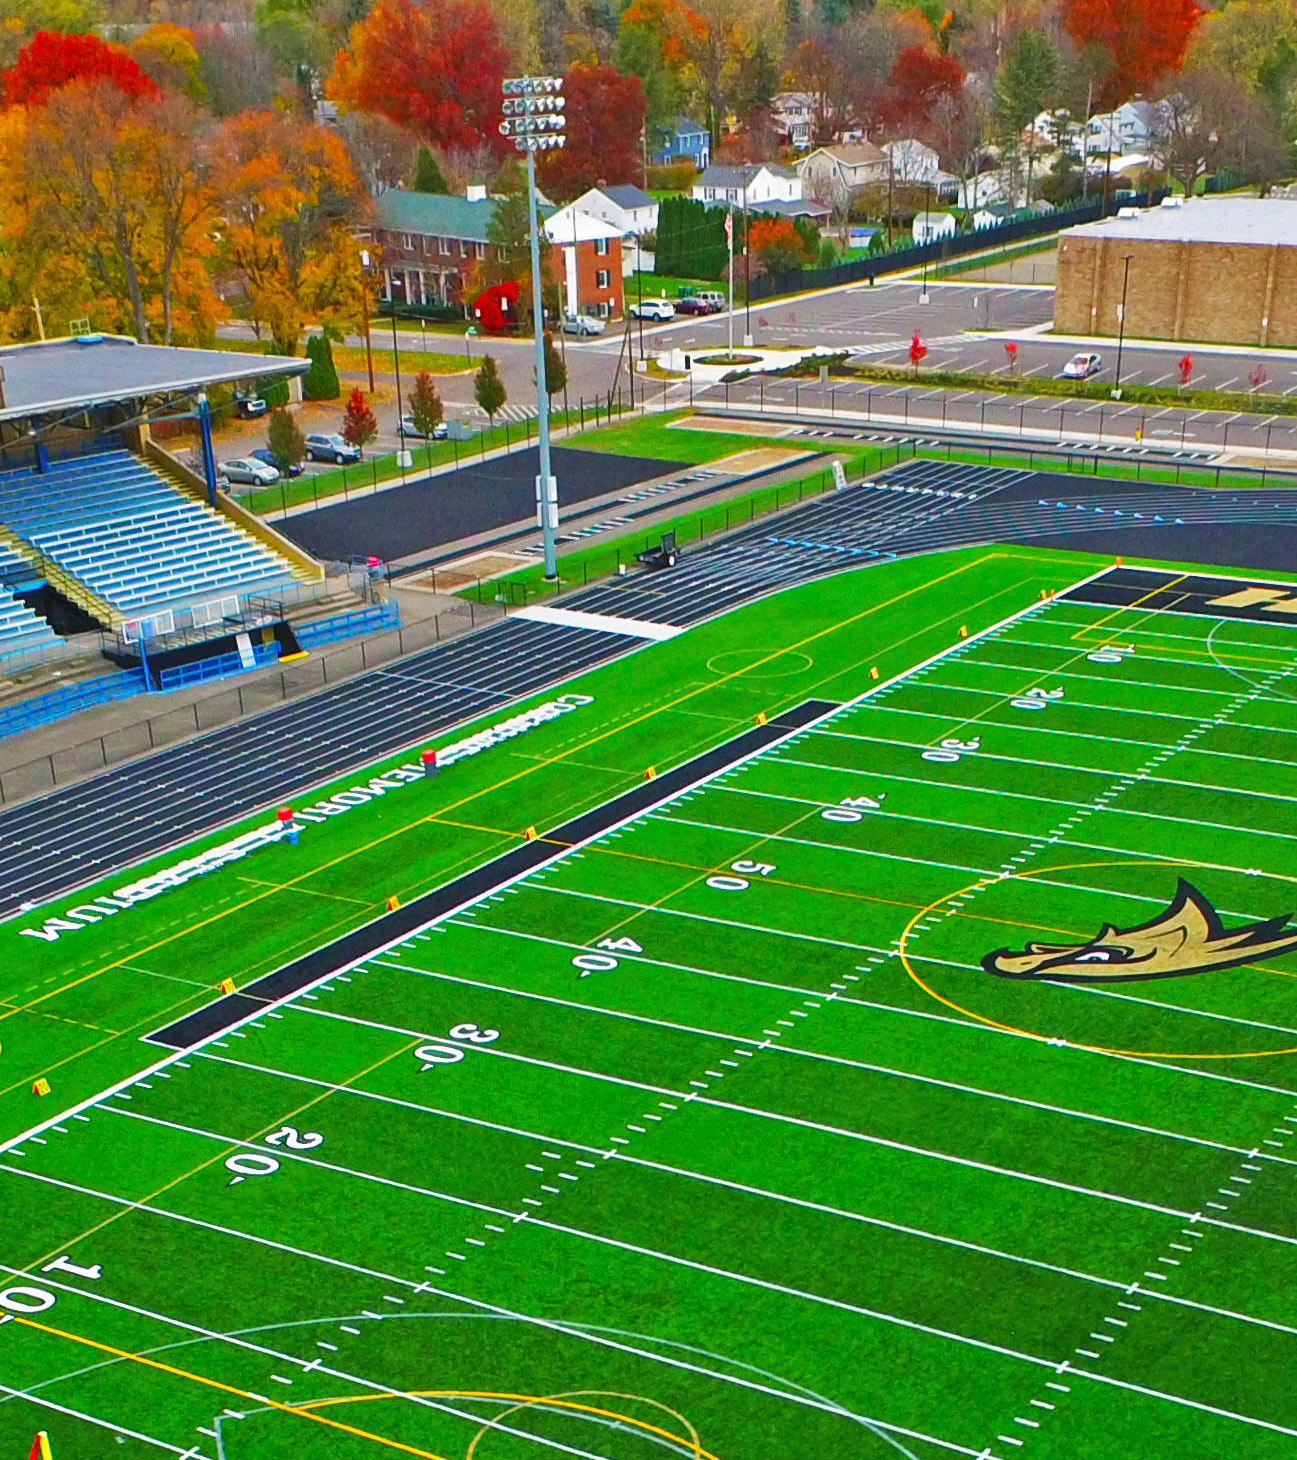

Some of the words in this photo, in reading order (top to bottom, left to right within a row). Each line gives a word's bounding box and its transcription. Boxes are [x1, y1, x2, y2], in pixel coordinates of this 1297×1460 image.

[1086, 645, 1136, 663] 10
[1010, 685, 1064, 711] 20
[922, 736, 981, 763] 30
[822, 796, 882, 823] 40
[706, 858, 776, 891] 50
[572, 936, 644, 972] 40
[414, 1023, 500, 1066] 30
[224, 1126, 324, 1178] 20
